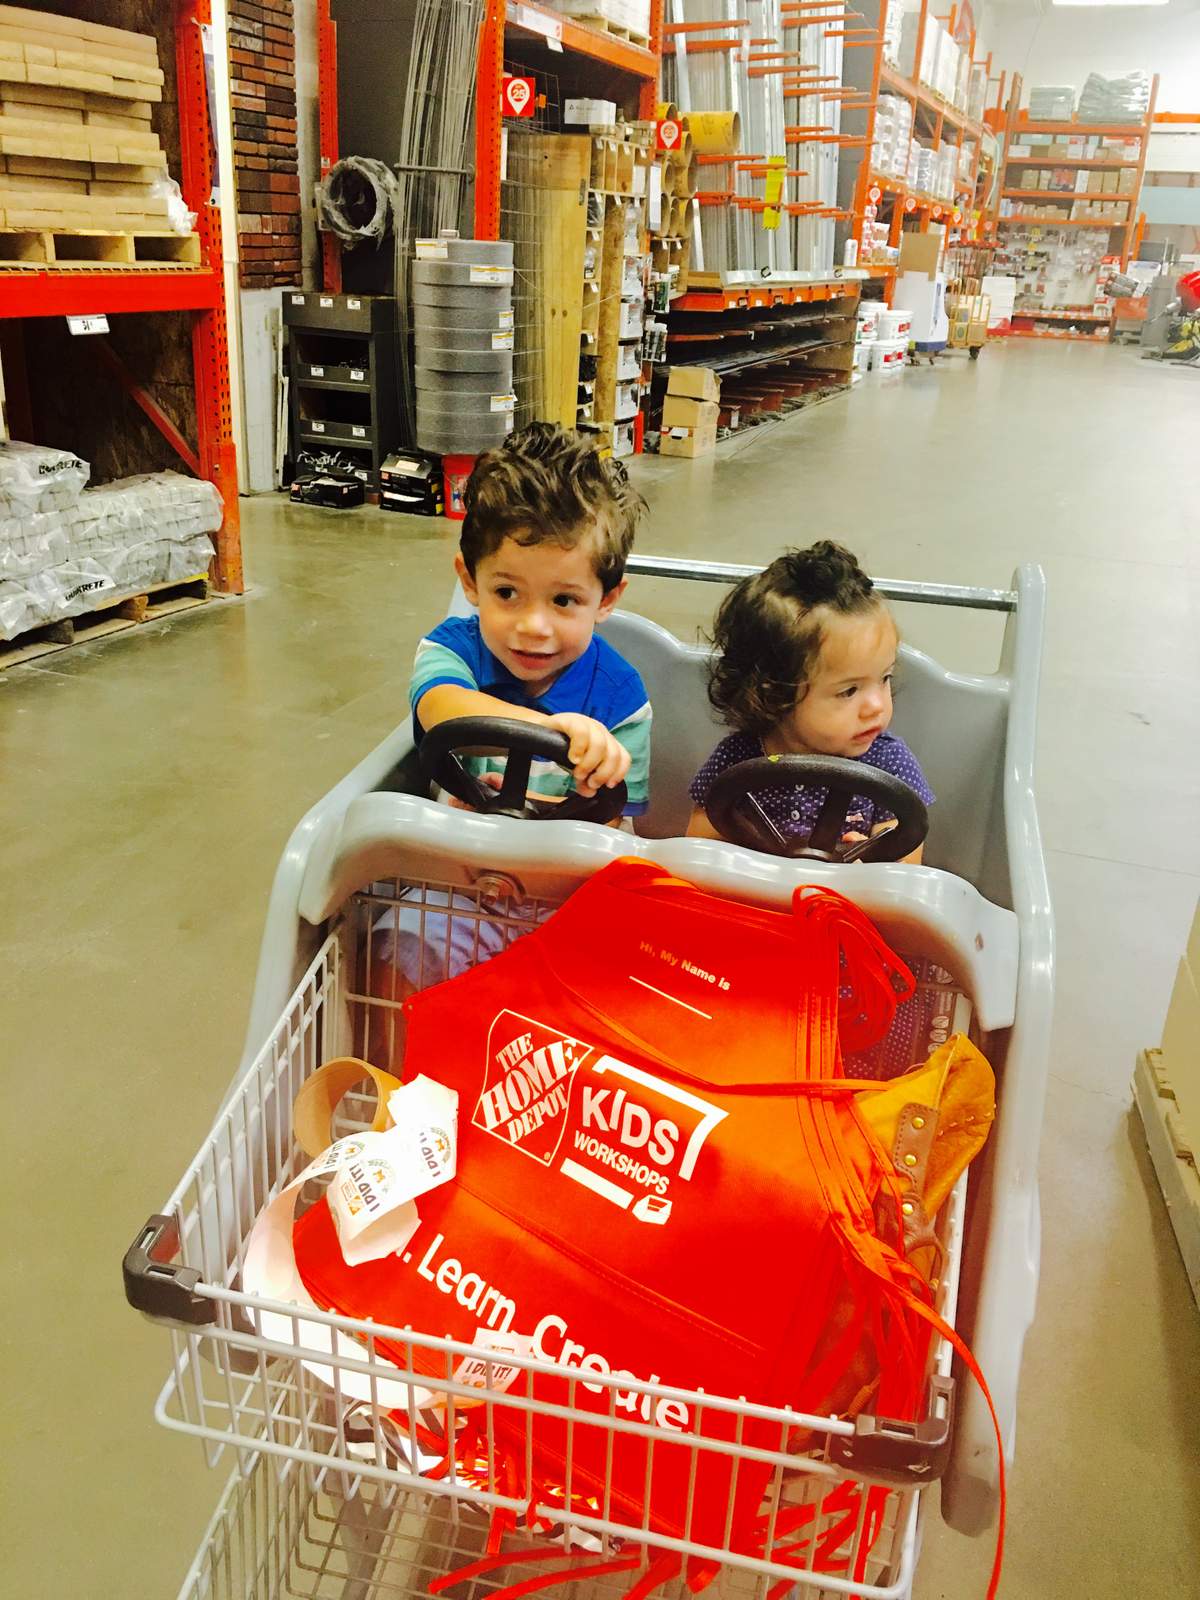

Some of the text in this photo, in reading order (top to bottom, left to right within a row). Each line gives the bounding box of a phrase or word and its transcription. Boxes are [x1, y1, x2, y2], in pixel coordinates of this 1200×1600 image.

[640, 941, 656, 957] Hi,
[660, 950, 678, 966] My
[681, 959, 716, 984] Name
[496, 1032, 534, 1073] THE
[480, 1038, 579, 1131] HOME
[506, 1083, 568, 1144] DEPOT
[582, 1086, 679, 1166] KIDS
[349, 1163, 365, 1183] IT!
[421, 1146, 439, 1170] DID
[574, 1130, 670, 1195] WORKSHOPS
[358, 1182, 377, 1205] DID
[471, 1362, 495, 1377] DI
[494, 1365, 513, 1380] IT!
